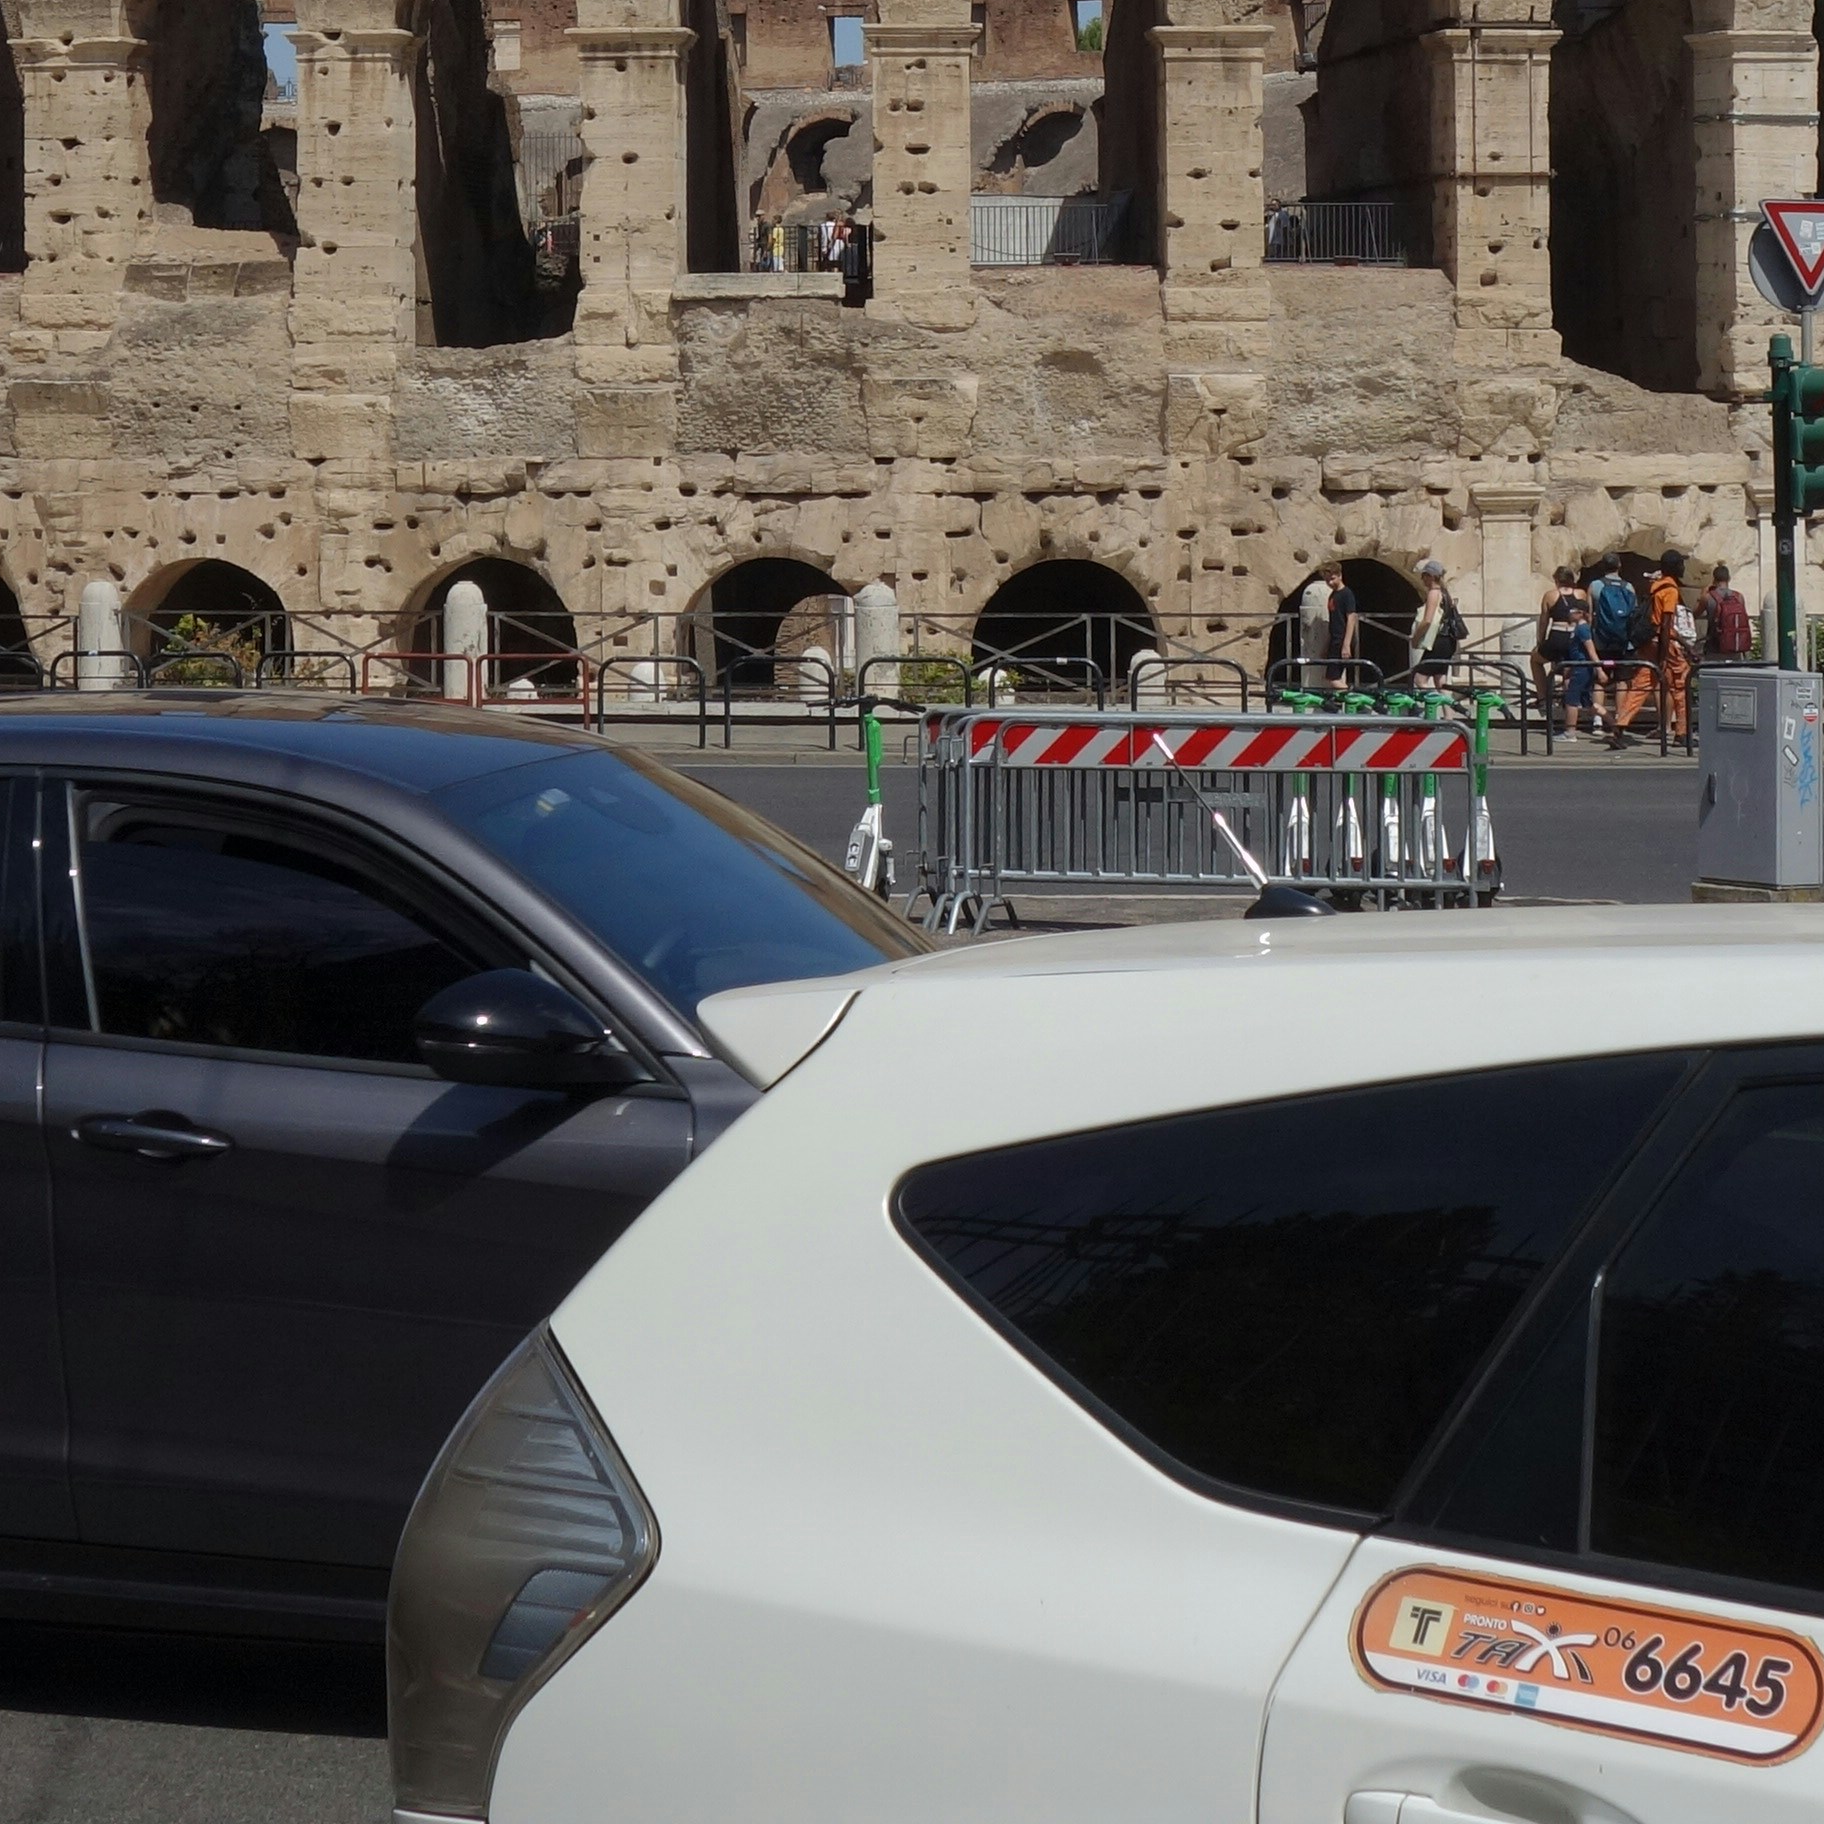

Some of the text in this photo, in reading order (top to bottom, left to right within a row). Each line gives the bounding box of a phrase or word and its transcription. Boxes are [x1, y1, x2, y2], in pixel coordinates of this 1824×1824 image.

[1462, 1612, 1508, 1632] PRONTO
[1416, 1667, 1448, 1687] VISA
[1603, 1626, 1794, 1720] 06 6645
